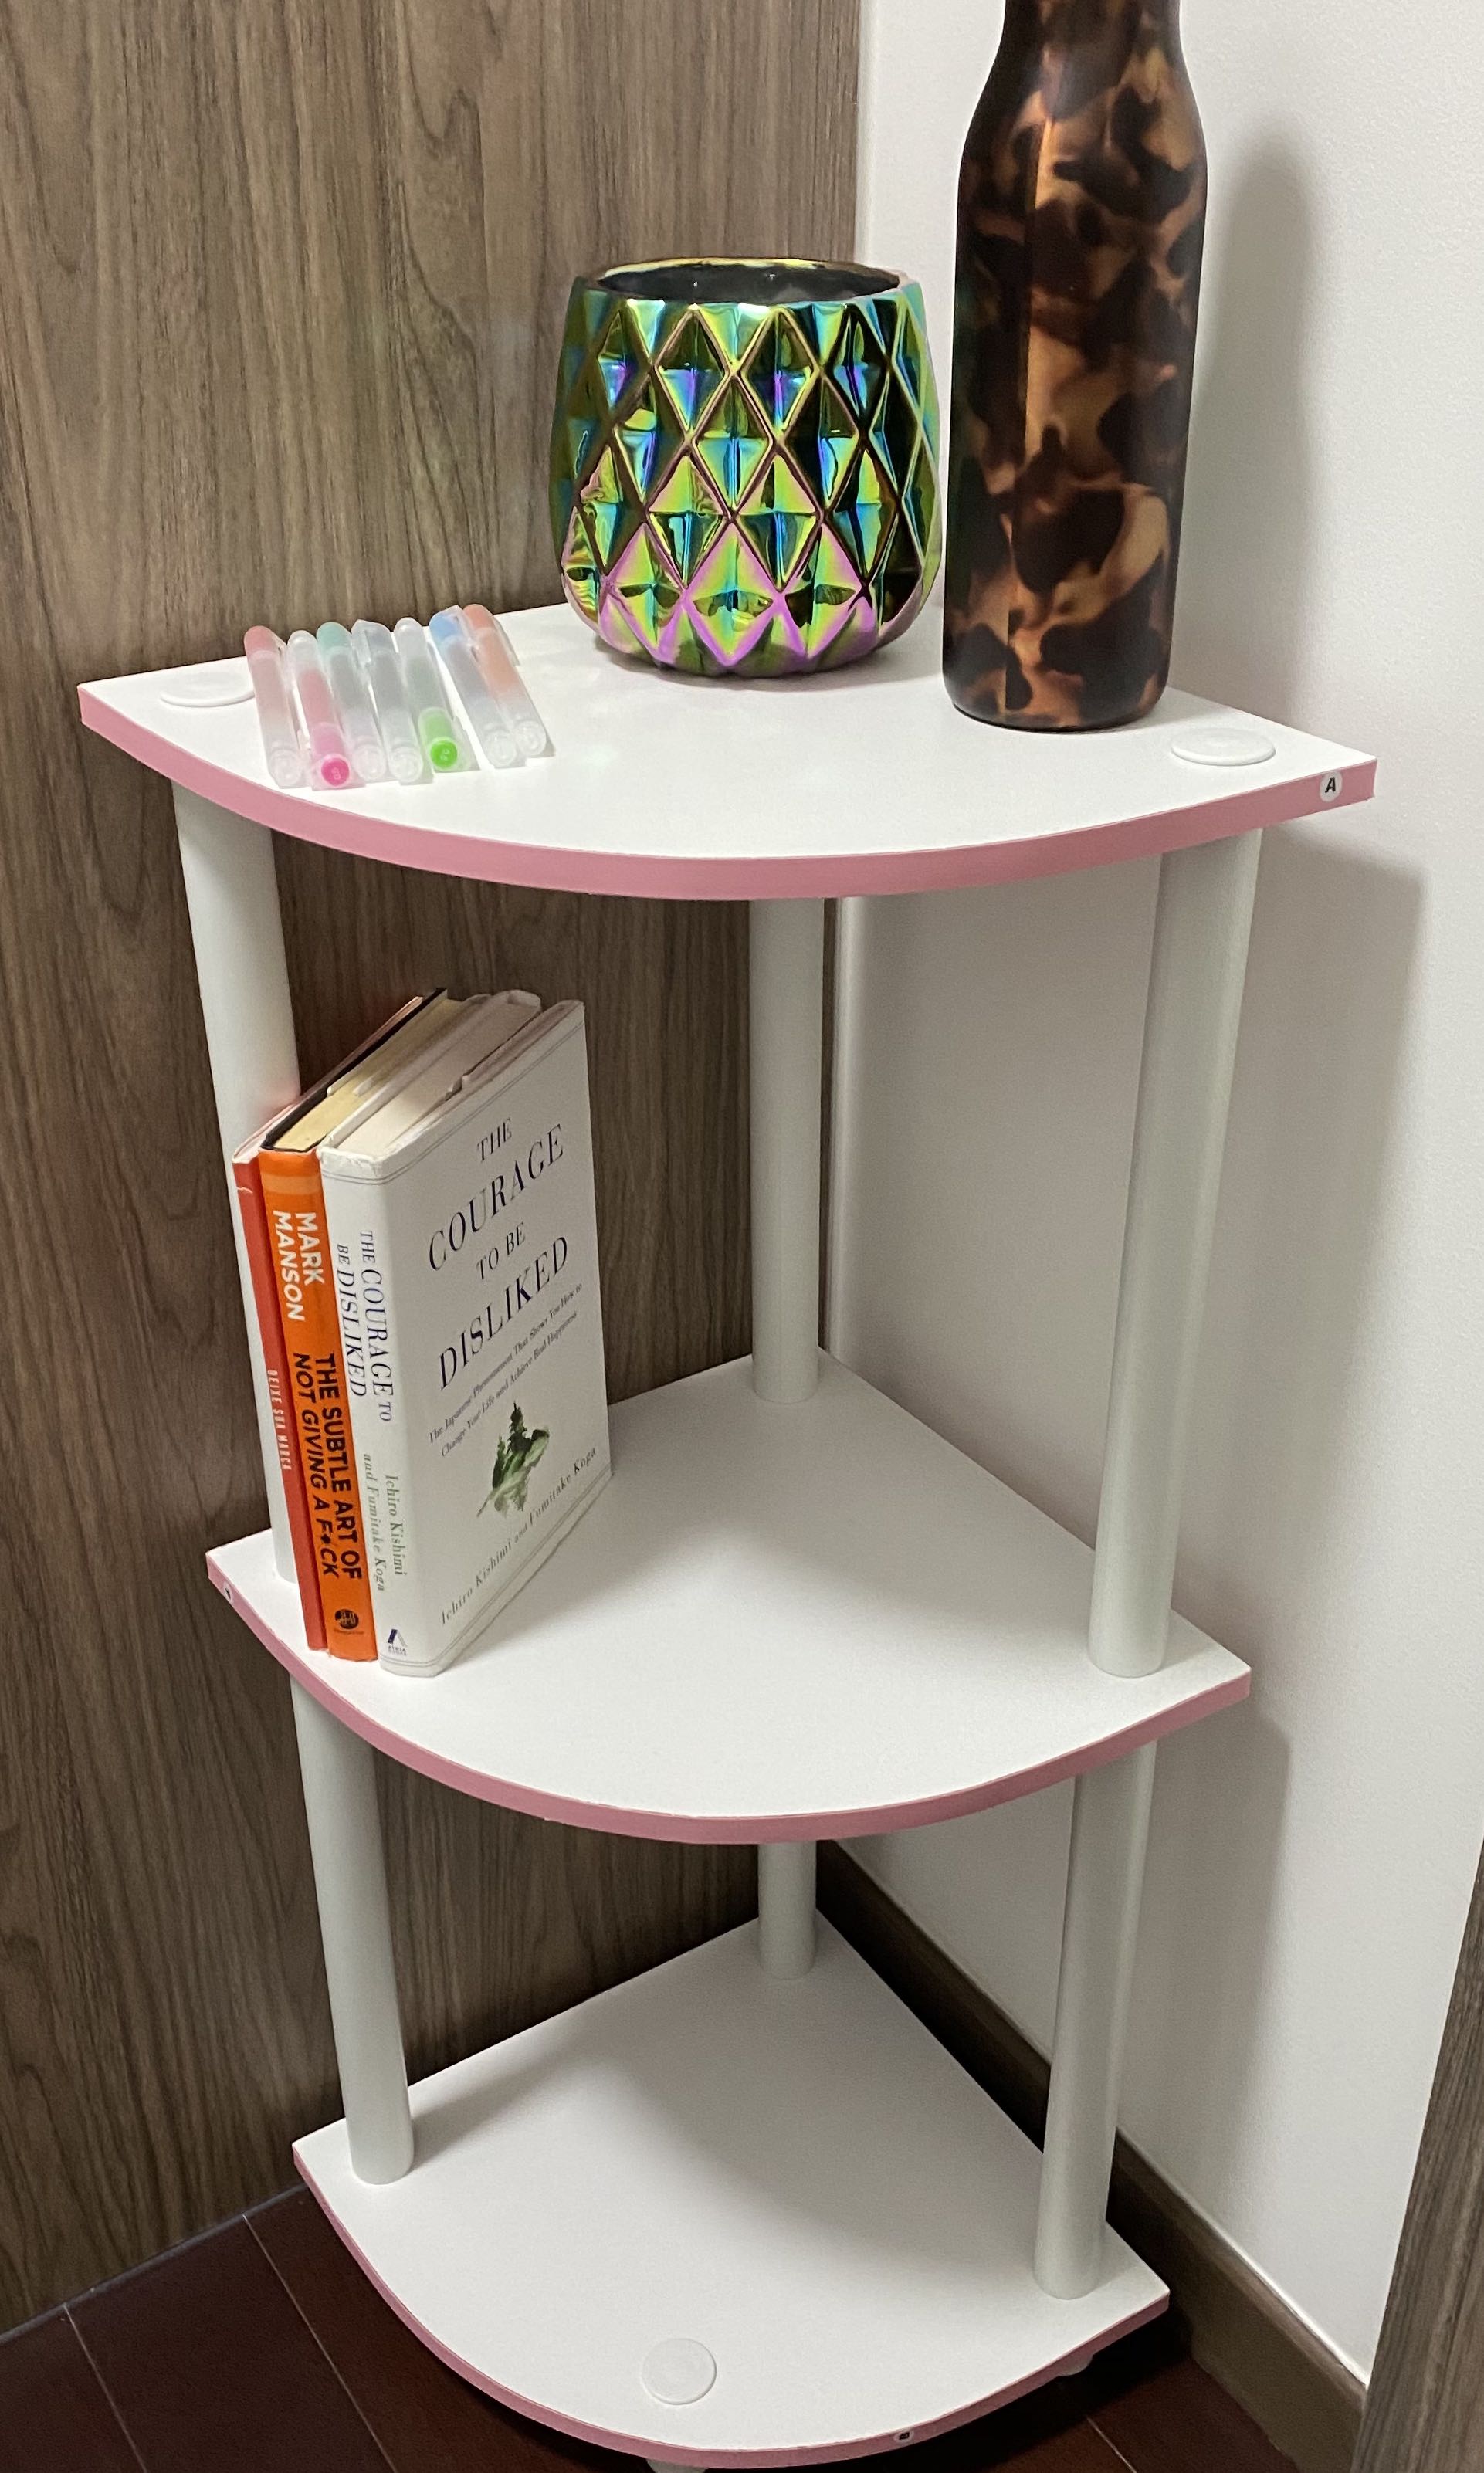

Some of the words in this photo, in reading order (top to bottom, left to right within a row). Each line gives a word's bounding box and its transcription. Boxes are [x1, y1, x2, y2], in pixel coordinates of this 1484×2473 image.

[1324, 777, 1337, 794] A
[476, 1117, 513, 1163] THE
[429, 1123, 564, 1271] COURAGE
[273, 1210, 305, 1321] MANSON
[295, 1212, 325, 1286] MARK
[337, 1244, 350, 1265] BE
[360, 1230, 376, 1263] THE
[476, 1248, 499, 1280] TO
[506, 1221, 526, 1256] BE
[337, 1268, 367, 1396] DISLIKED
[361, 1269, 394, 1395] COURAGE
[439, 1236, 568, 1391] DISLIKED
[293, 1353, 316, 1404] NOT
[315, 1353, 340, 1400] THE
[378, 1401, 392, 1421] TO
[301, 1409, 328, 1489] GIVING
[322, 1407, 352, 1492] SUBTLE
[364, 1454, 378, 1481] and
[313, 1493, 330, 1510] A
[334, 1499, 357, 1543] ART
[367, 1485, 384, 1553] Fumitake
[385, 1475, 400, 1517] Ichiro
[390, 1523, 408, 1575] Kishimi
[442, 1587, 473, 1624] Ichiro
[476, 1537, 511, 1587] Kishimi
[573, 1447, 596, 1476] Koga
[341, 1550, 362, 1579] OF
[374, 1557, 386, 1591] Koga
